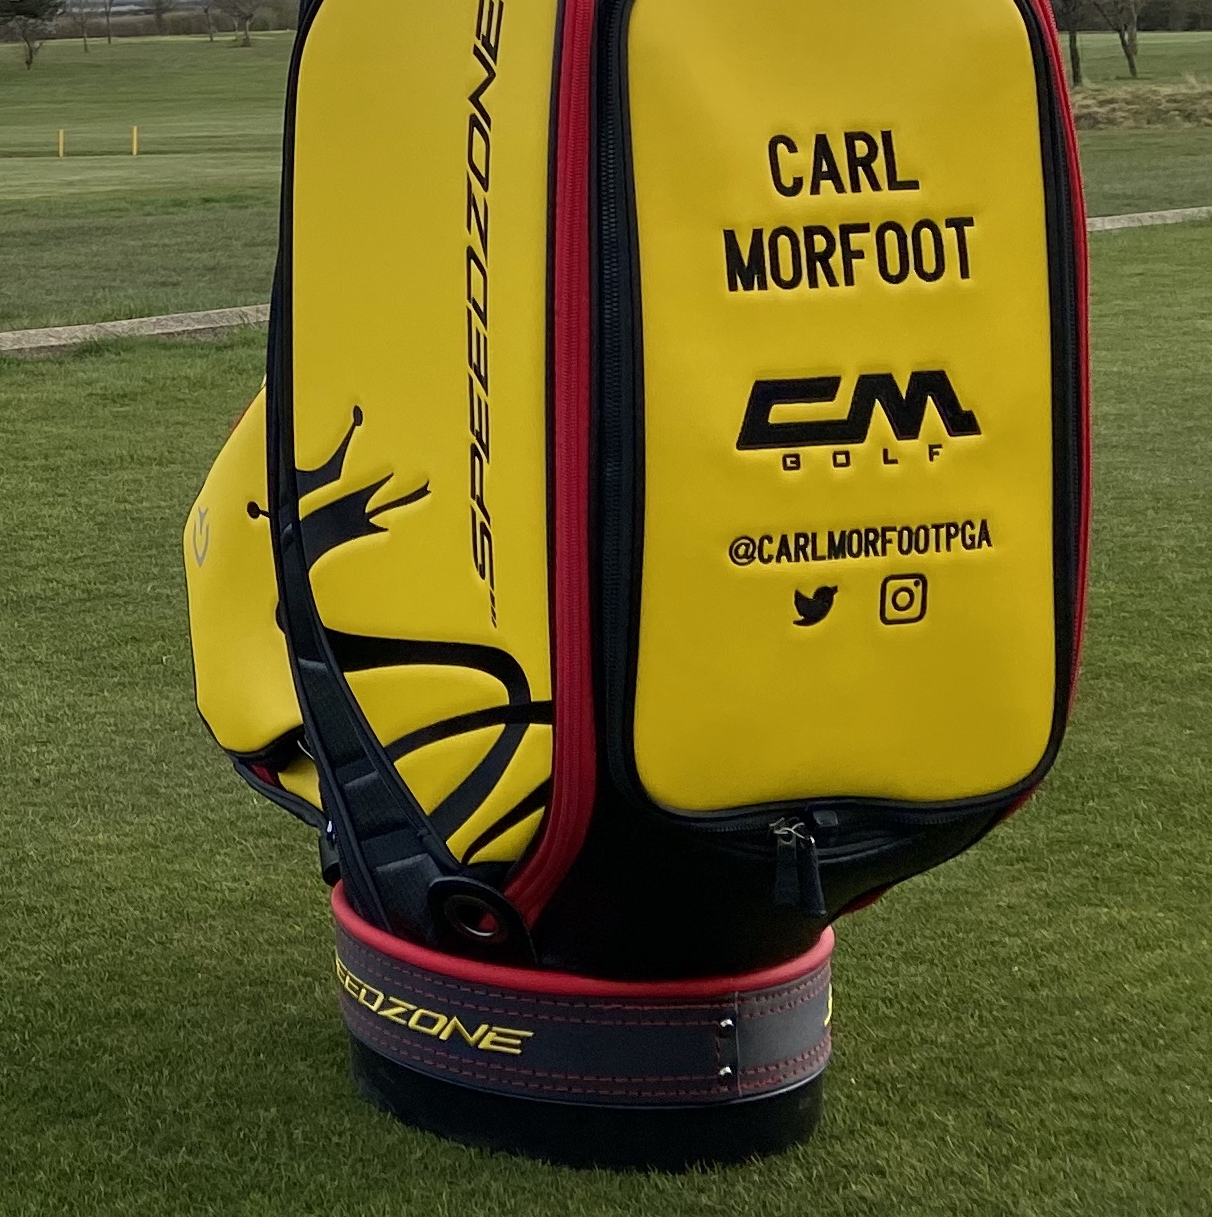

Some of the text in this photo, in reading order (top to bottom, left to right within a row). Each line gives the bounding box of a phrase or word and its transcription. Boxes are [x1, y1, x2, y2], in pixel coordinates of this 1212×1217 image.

[768, 130, 920, 197] CARL
[723, 216, 975, 292] MORFOOT
[736, 370, 982, 451] CM
[782, 444, 943, 471] GOLF
[729, 519, 993, 566] @CARLMORFOOTPGA
[334, 946, 534, 1055] EEDZONE
